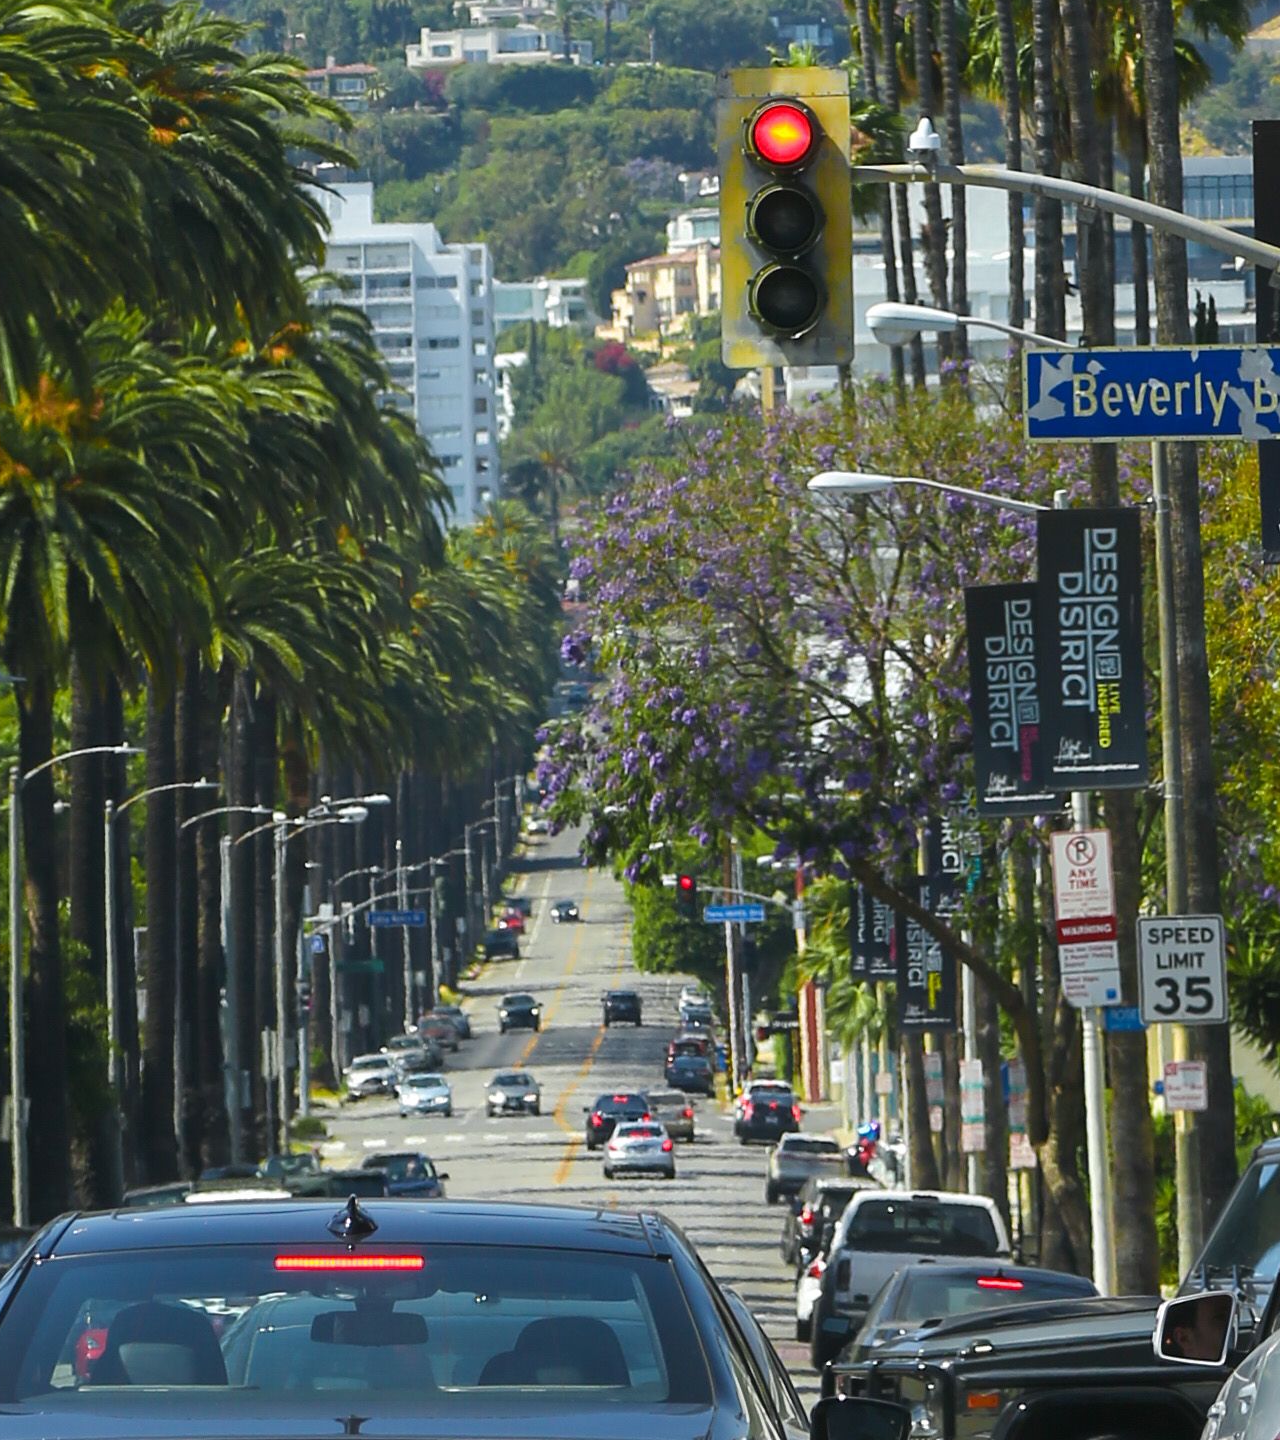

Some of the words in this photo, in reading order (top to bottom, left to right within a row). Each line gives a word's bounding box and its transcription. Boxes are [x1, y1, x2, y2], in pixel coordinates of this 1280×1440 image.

[1072, 372, 1229, 427] Beverly
[1091, 528, 1120, 651] DESIGN
[1010, 599, 1037, 700] DESIGN
[1108, 683, 1121, 714] LIVE
[1097, 683, 1112, 749] INSPIRED
[1068, 868, 1097, 879] ANY
[1068, 878, 1099, 890] TIME
[1061, 923, 1113, 937] WARNING
[1147, 926, 1215, 945] SPEED
[1155, 951, 1206, 970] LIMIT
[1152, 975, 1214, 1016] 35
